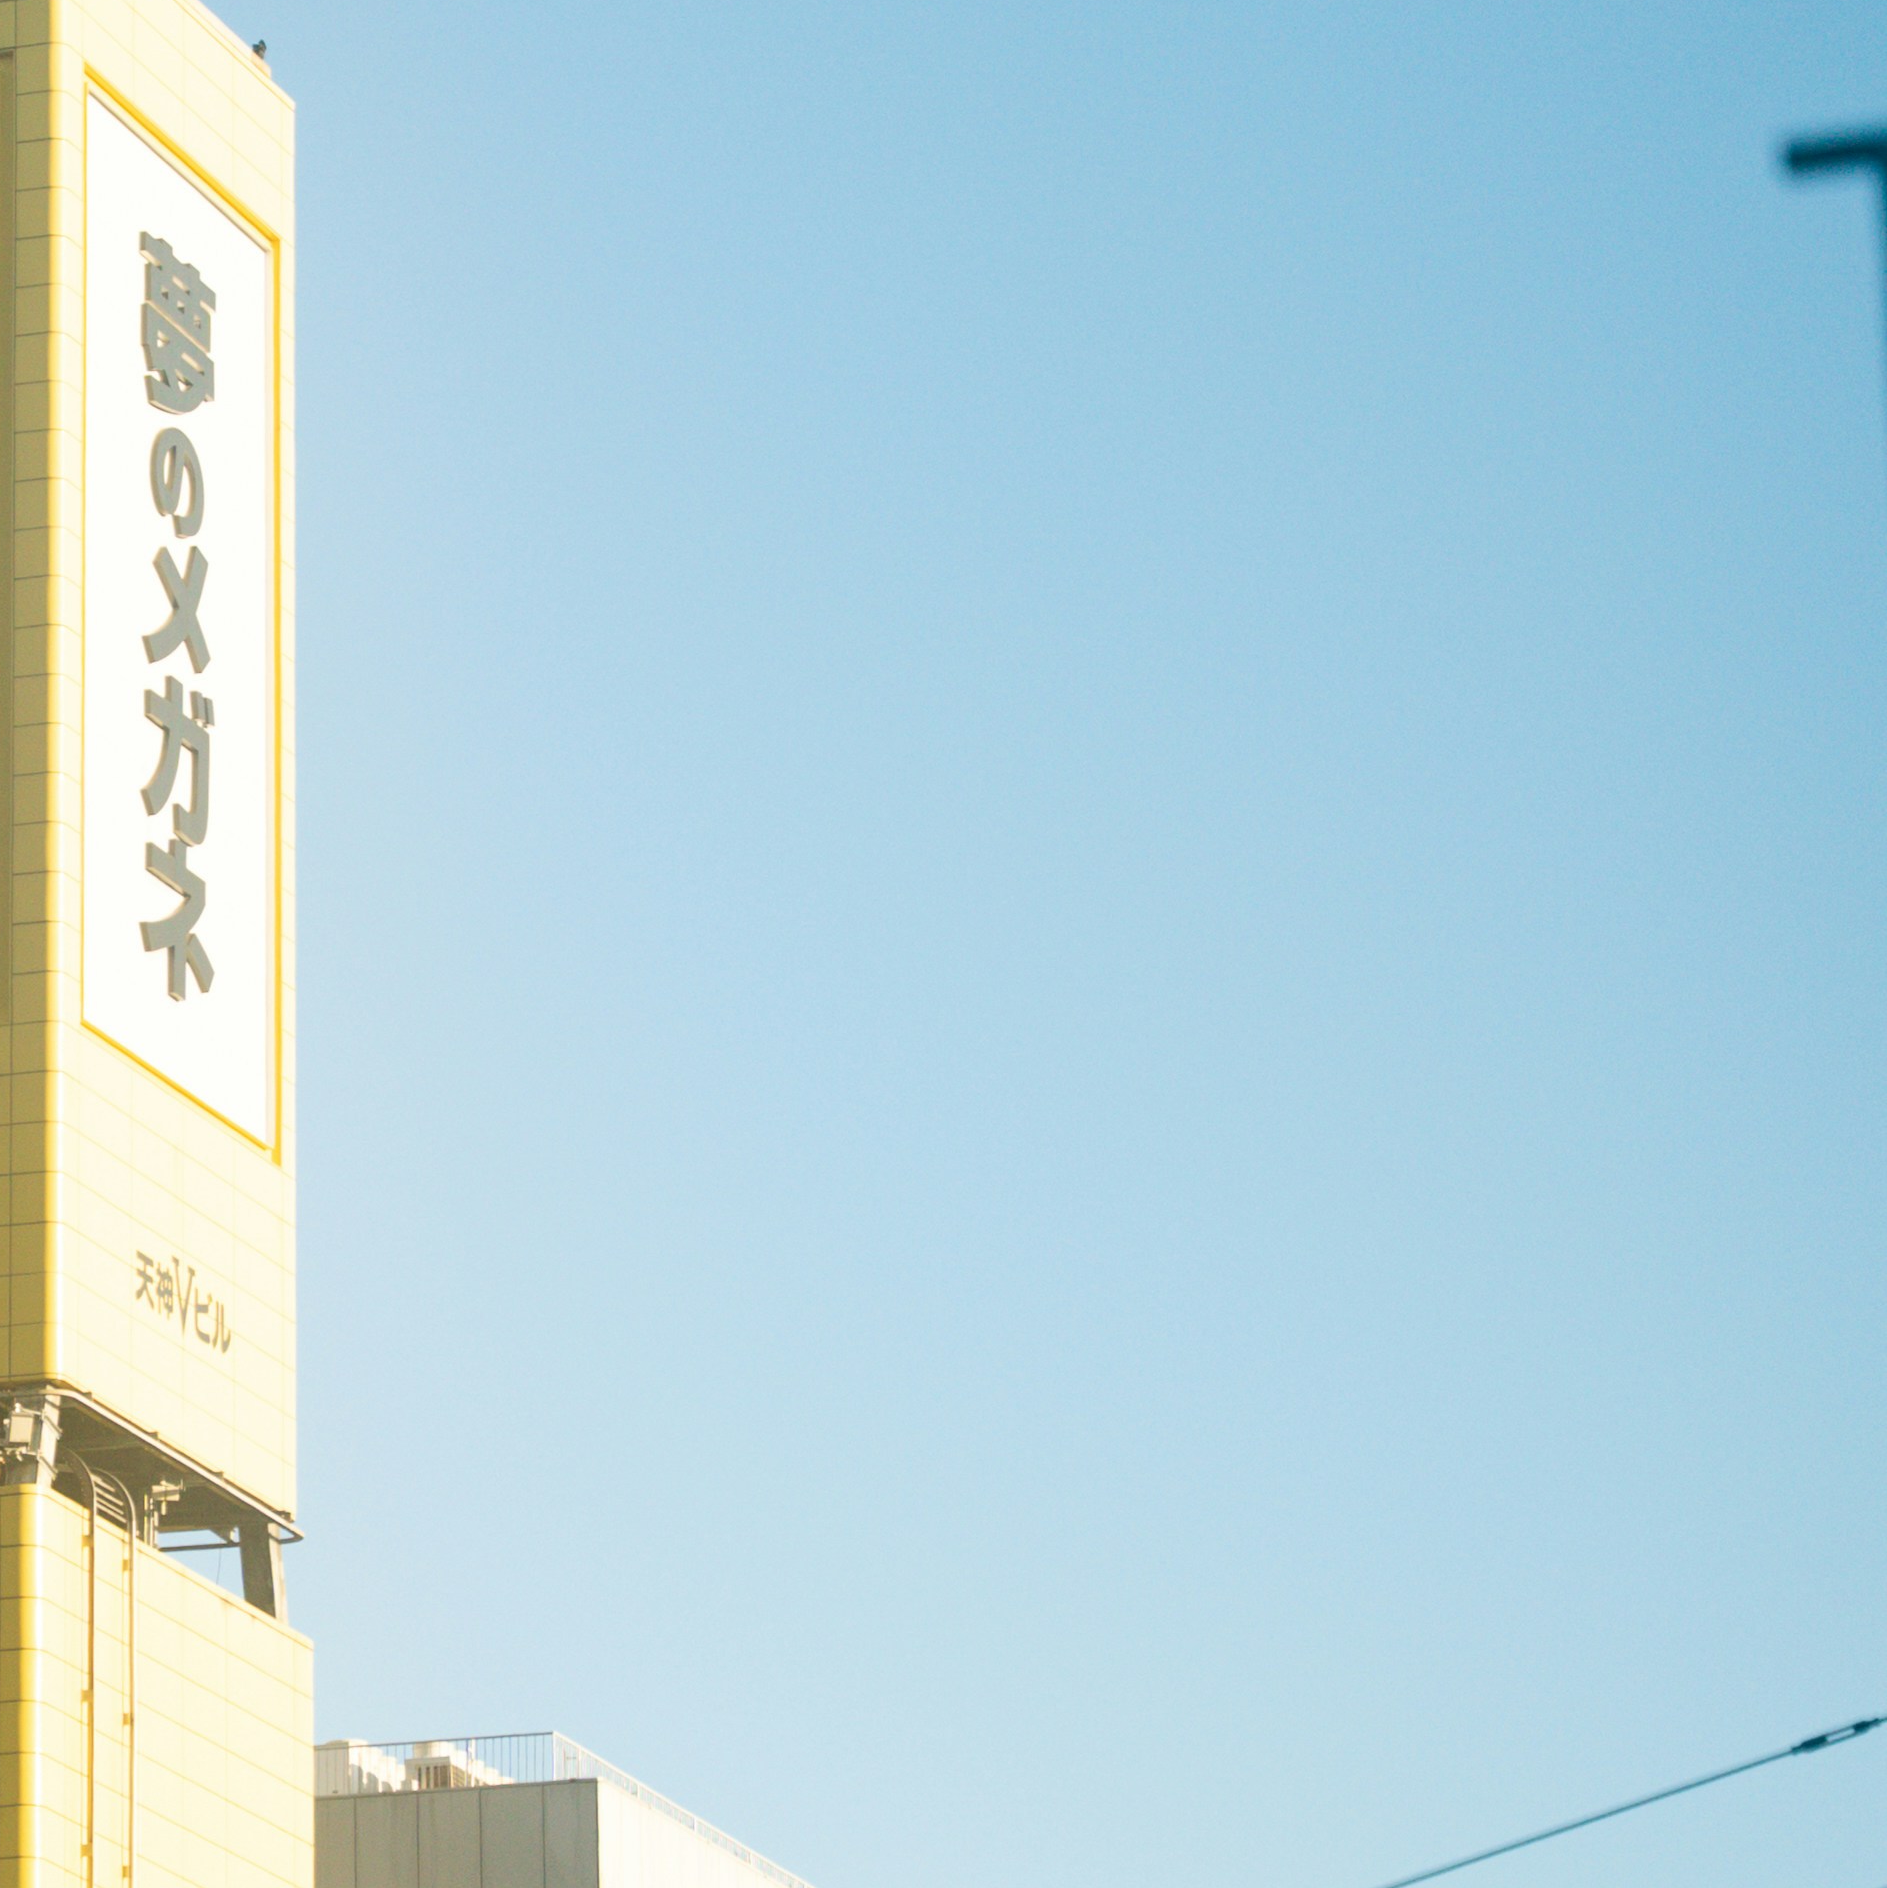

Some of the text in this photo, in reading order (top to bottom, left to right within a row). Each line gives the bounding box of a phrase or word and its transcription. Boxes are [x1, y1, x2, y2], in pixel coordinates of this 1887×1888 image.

[137, 230, 218, 1003] 夢のメガネ
[132, 1250, 232, 1357] 天神Vビル
